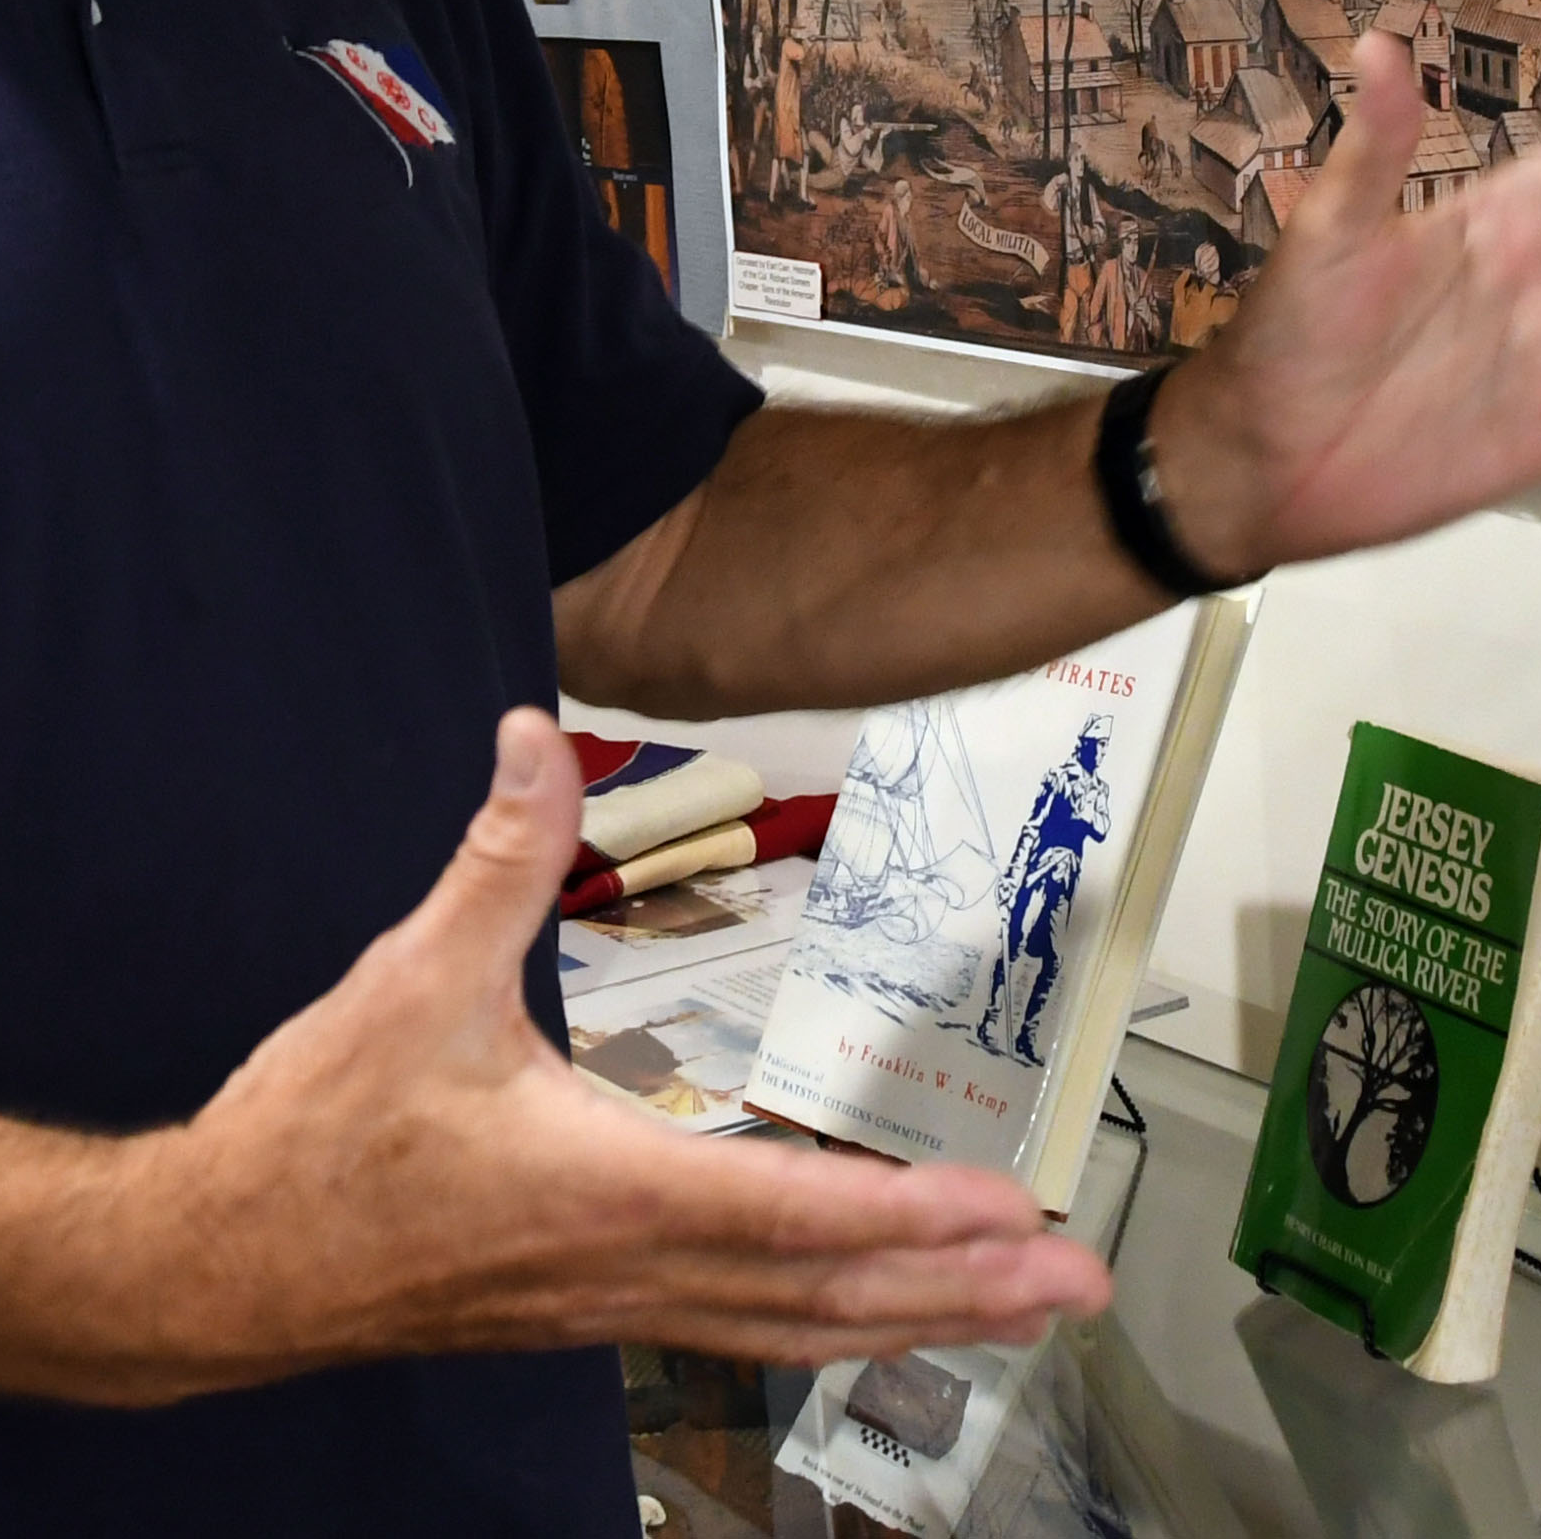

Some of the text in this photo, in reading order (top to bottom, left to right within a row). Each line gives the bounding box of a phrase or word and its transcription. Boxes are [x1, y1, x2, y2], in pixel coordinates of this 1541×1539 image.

[961, 210, 1037, 261] LOCAL MILITIA
[1045, 660, 1137, 698] PIRATES
[1374, 781, 1496, 869] JERSEY
[1354, 827, 1495, 924] GENESIS
[1324, 877, 1508, 987] THE STORY OF THE
[1326, 917, 1483, 1015] MULLICA RIVER
[760, 1070, 779, 1089] THE
[822, 1095, 875, 1125] CITIZENS
[874, 1115, 945, 1153] COMMITTEE
[838, 1035, 1009, 1119] by Franklin W. Kemp
